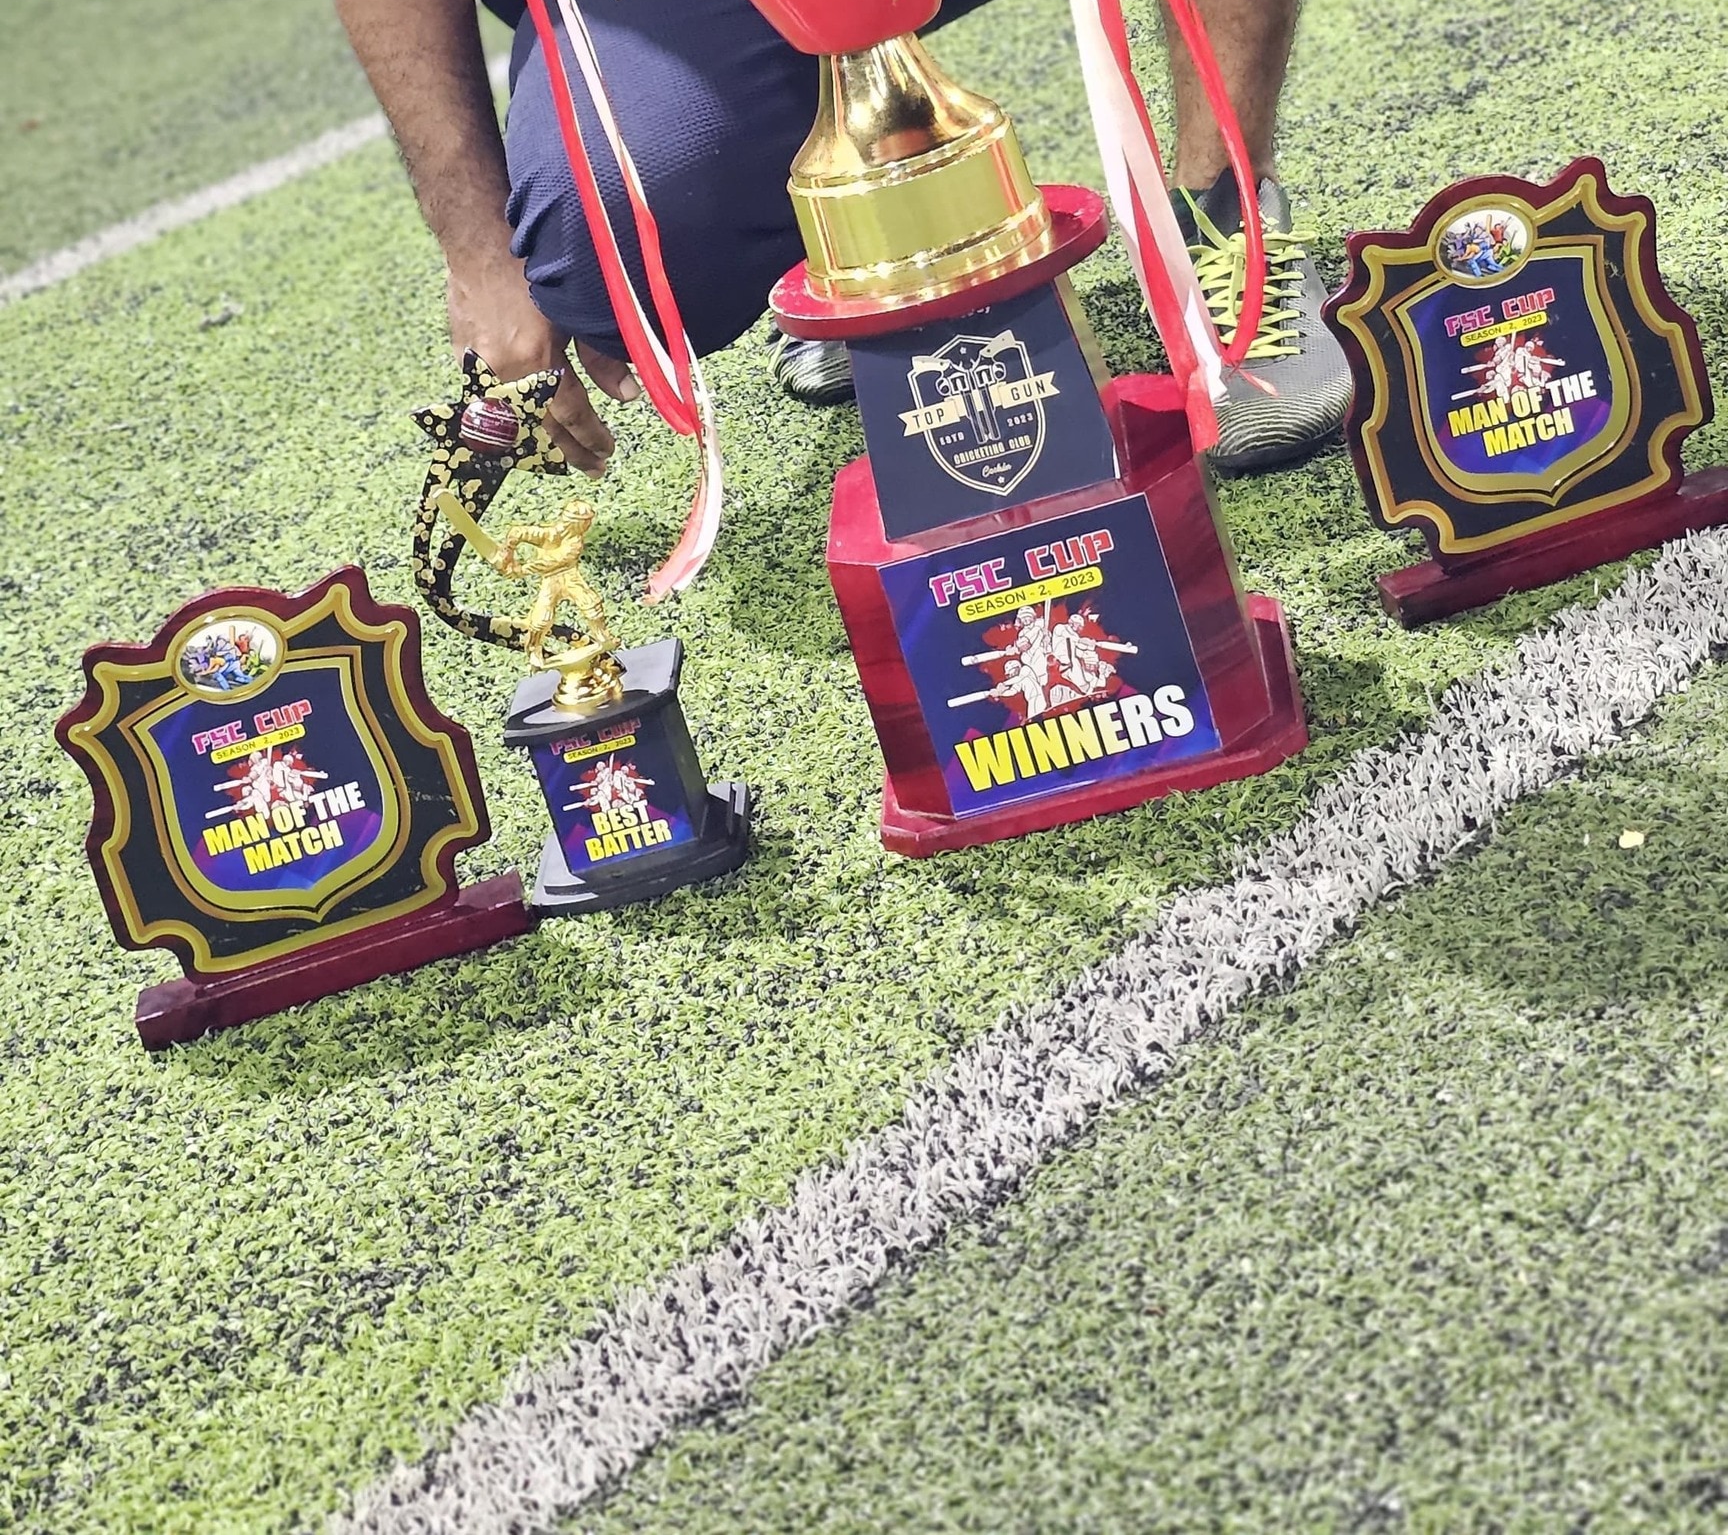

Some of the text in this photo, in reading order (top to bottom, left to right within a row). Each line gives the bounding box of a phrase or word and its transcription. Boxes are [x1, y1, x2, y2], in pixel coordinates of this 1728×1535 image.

[1444, 288, 1555, 337] FSC CUP
[1464, 327, 1502, 343] SEASON
[1522, 315, 1543, 326] 2023
[912, 380, 1047, 429] TOP GUN
[1448, 370, 1597, 438] MAN OF THE
[939, 413, 1034, 446] ESTD 2023
[1482, 408, 1574, 457] MATCH
[929, 529, 1114, 607] FSC CUP
[964, 589, 1027, 616] SEASON
[1062, 571, 1096, 590] 2023
[192, 699, 312, 755] FSC CUP
[215, 741, 257, 760] SEASON
[278, 726, 301, 740] 2023
[549, 717, 642, 756] FSC CUP
[953, 684, 1195, 793] WINNERS
[567, 746, 598, 760] SEASON
[202, 781, 366, 857] MAN OF THE
[585, 818, 673, 862] BATTER
[591, 799, 650, 836] BEST
[243, 819, 344, 875] MATCH
